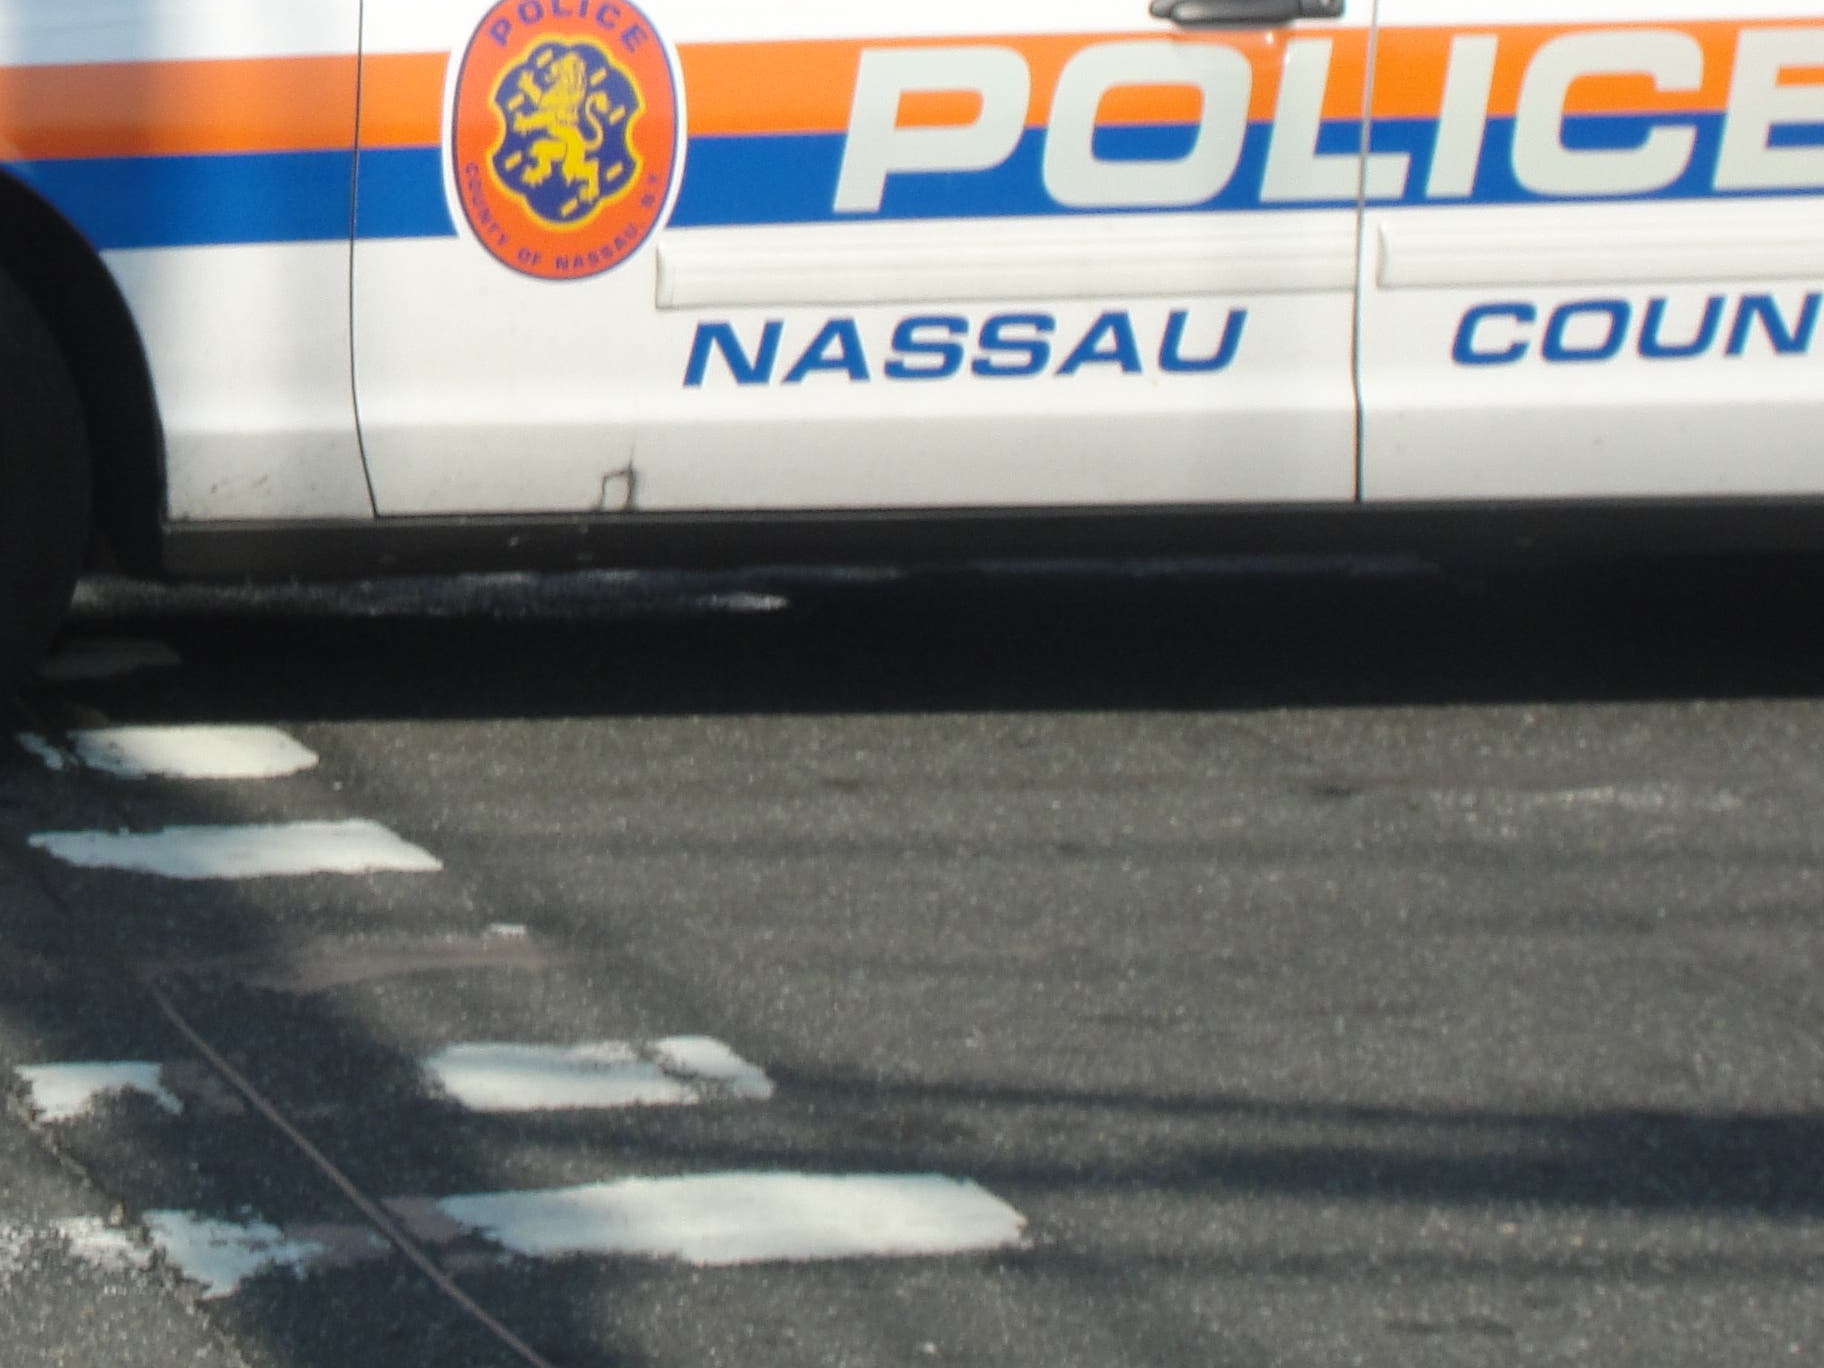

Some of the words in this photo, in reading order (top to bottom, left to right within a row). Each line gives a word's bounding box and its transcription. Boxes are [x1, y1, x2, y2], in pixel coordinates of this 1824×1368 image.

[832, 28, 1824, 213] POLICE
[554, 222, 639, 271] NASSAU
[683, 308, 1248, 388] NASSAU
[1451, 291, 1823, 365] COUN
